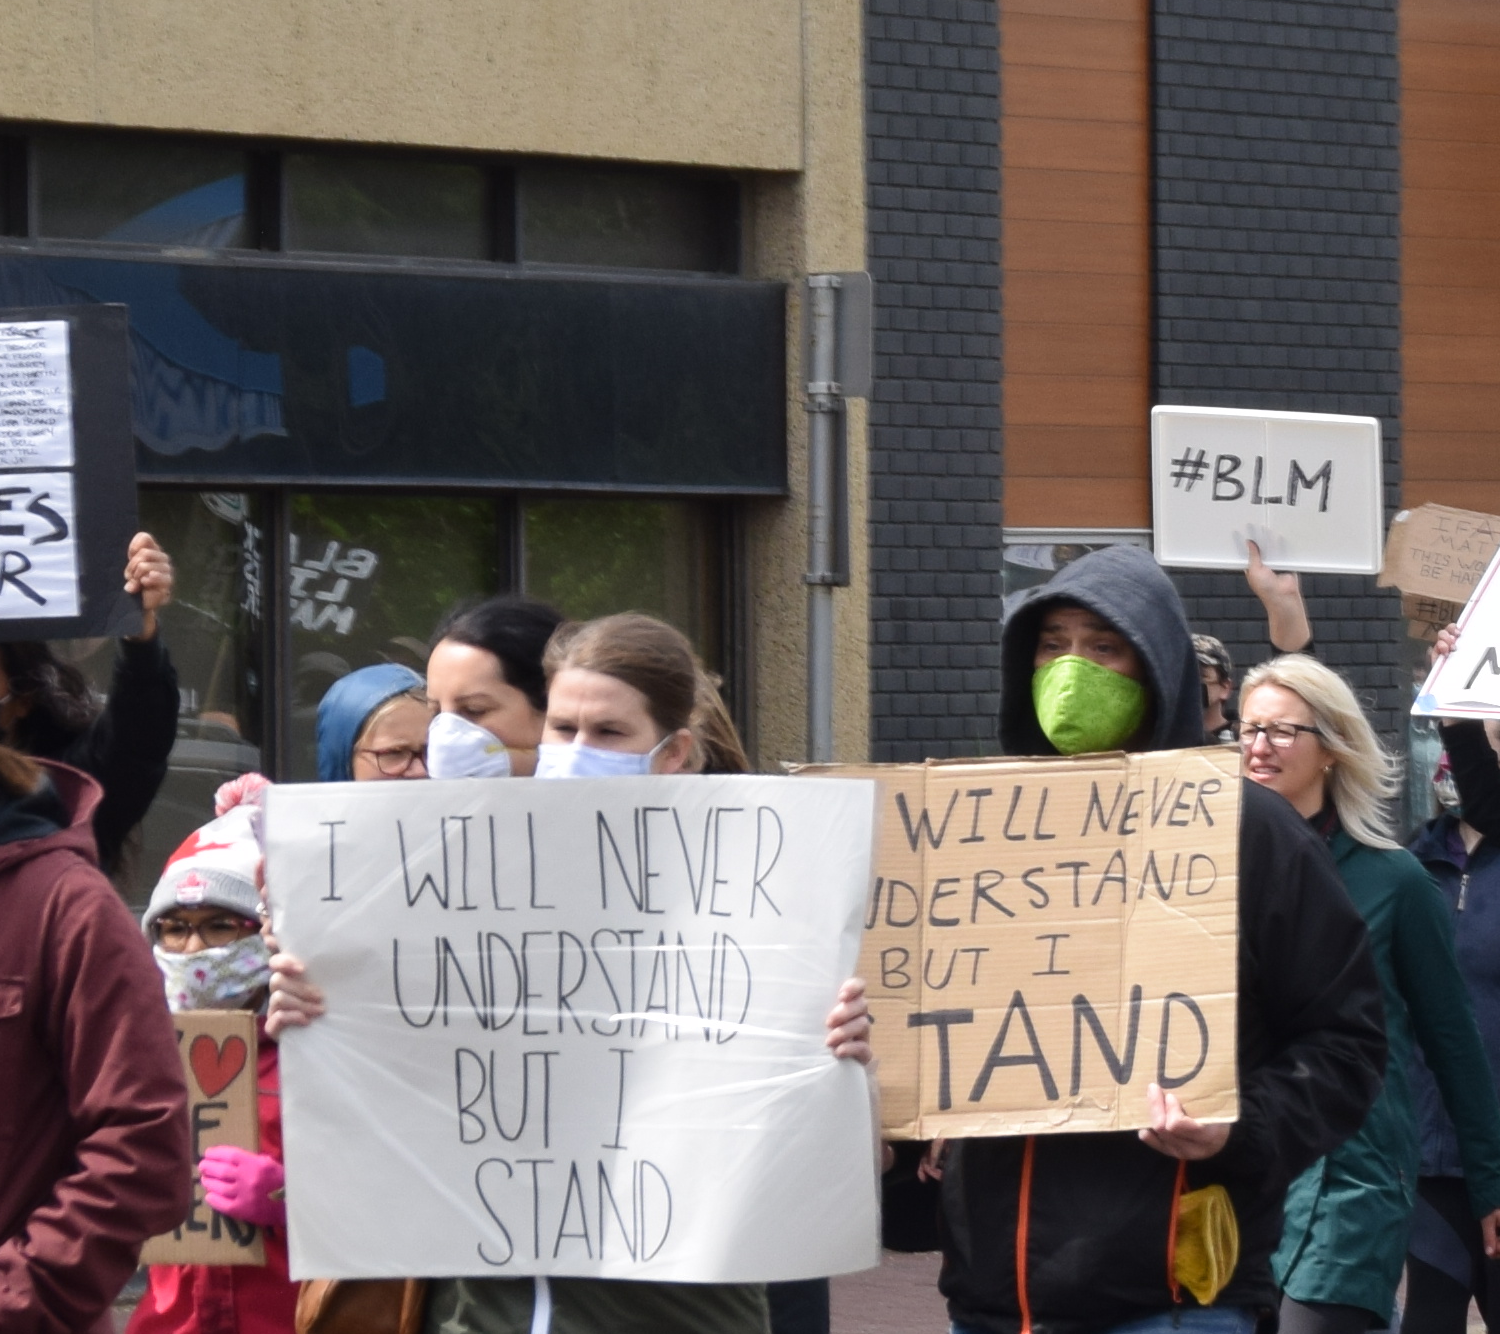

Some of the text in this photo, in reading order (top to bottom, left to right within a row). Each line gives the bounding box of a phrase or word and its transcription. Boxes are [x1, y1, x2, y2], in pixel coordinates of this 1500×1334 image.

[1170, 446, 1334, 513] #BLM
[1410, 547, 1451, 566] THIS
[1421, 564, 1443, 579] BE
[895, 776, 1222, 853] WILL NEVER
[320, 805, 784, 918] I WILL NEVER
[393, 928, 752, 1045] UNDERSTAND
[879, 933, 1070, 989] BUT I
[866, 984, 1210, 1110] TAND
[454, 1047, 634, 1151] BUT I
[474, 1157, 673, 1266] STAND
